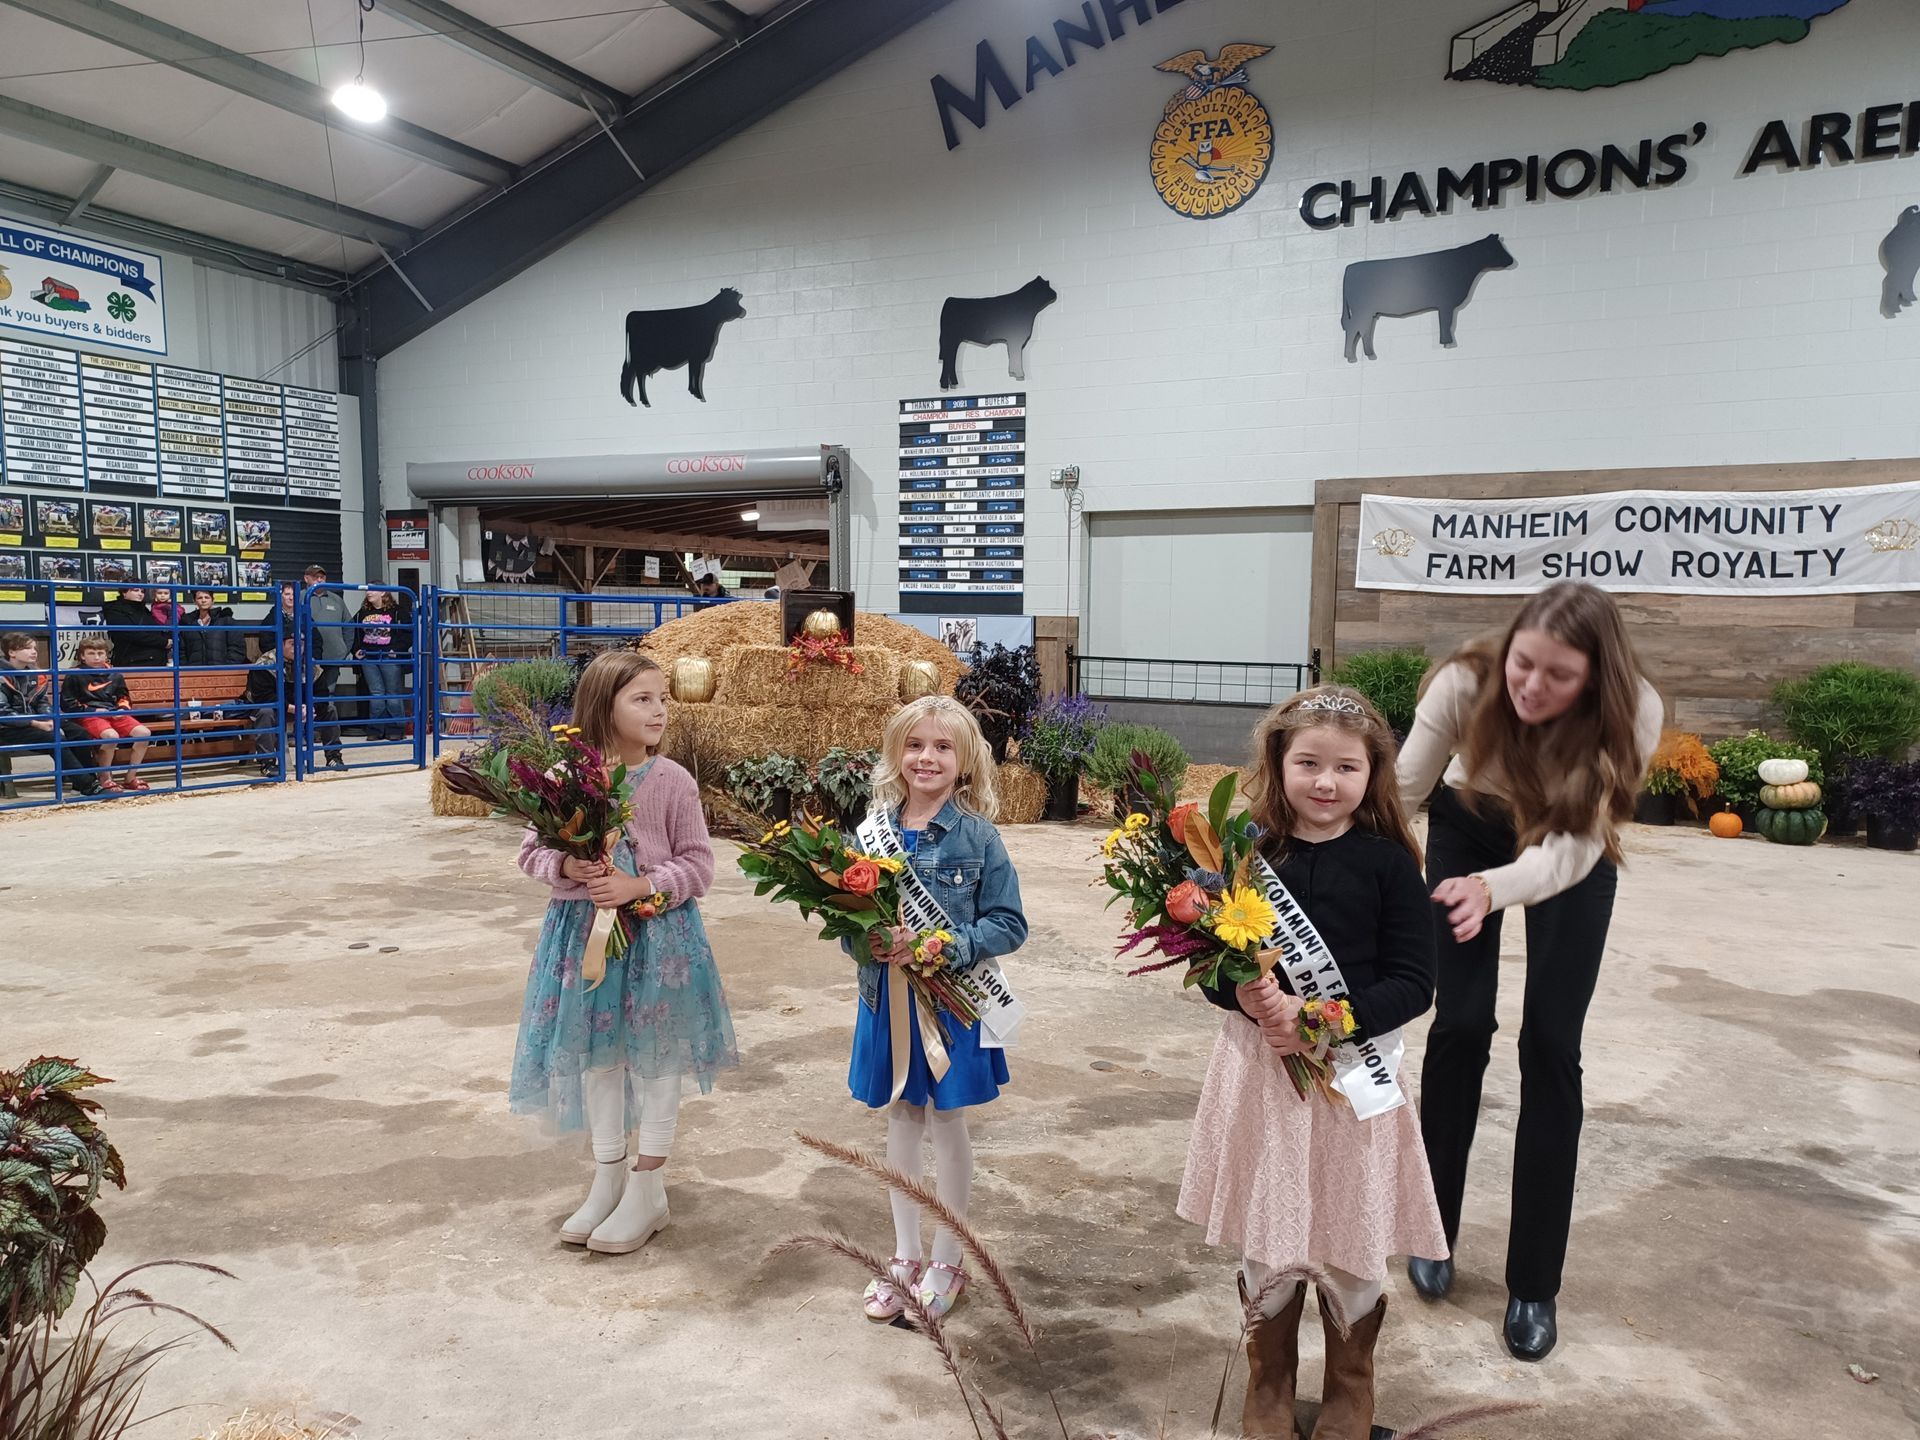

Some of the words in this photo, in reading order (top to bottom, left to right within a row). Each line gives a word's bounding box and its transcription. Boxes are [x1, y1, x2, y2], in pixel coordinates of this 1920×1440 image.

[1168, 103, 1253, 146] AGRICULTURAL
[1188, 118, 1235, 142] FFA
[1174, 168, 1245, 197] EDUCATION
[23, 238, 45, 253] OF
[49, 244, 139, 278] CHAMPIONS
[17, 311, 41, 323] you
[45, 312, 89, 332] buyers
[94, 323, 102, 333] &
[106, 328, 151, 343] bidders
[101, 359, 124, 368] COUNTRY
[12, 368, 46, 378] BROOKLAWN
[119, 387, 139, 395] NAUMAN
[28, 393, 56, 403] INSURANCE
[912, 401, 935, 409] THANKS
[985, 397, 1009, 405] BUYERS
[21, 403, 37, 411] JAMES
[229, 403, 261, 412] BOMBERGER'S
[264, 406, 278, 414] STORE
[8, 414, 24, 422] MARVIN
[111, 411, 137, 419] TRANSPORT
[913, 412, 948, 420] CHAMPION
[985, 409, 1022, 417] CHAMPION
[14, 425, 34, 435] TEDESCO
[36, 427, 73, 440] CONSTRUCTION
[128, 425, 141, 433] MILLS
[123, 437, 137, 445] FAMILY
[162, 432, 193, 442] ROHRER'S
[196, 436, 220, 445] QUARRY
[52, 442, 68, 450] FAMILY
[31, 462, 45, 470] JOHN
[46, 464, 61, 472] HURST
[47, 475, 71, 484] TRUCKING
[1432, 510, 1588, 538] MANHEIM
[1615, 504, 1842, 535] COMMUNITY
[1426, 553, 1516, 580] FARM
[1542, 550, 1643, 579] SHOW
[1671, 548, 1846, 579] ROYALTY
[978, 969, 1014, 1008] SHOW
[1265, 881, 1334, 974] COMMUNITY
[1358, 1042, 1392, 1086] HOW
